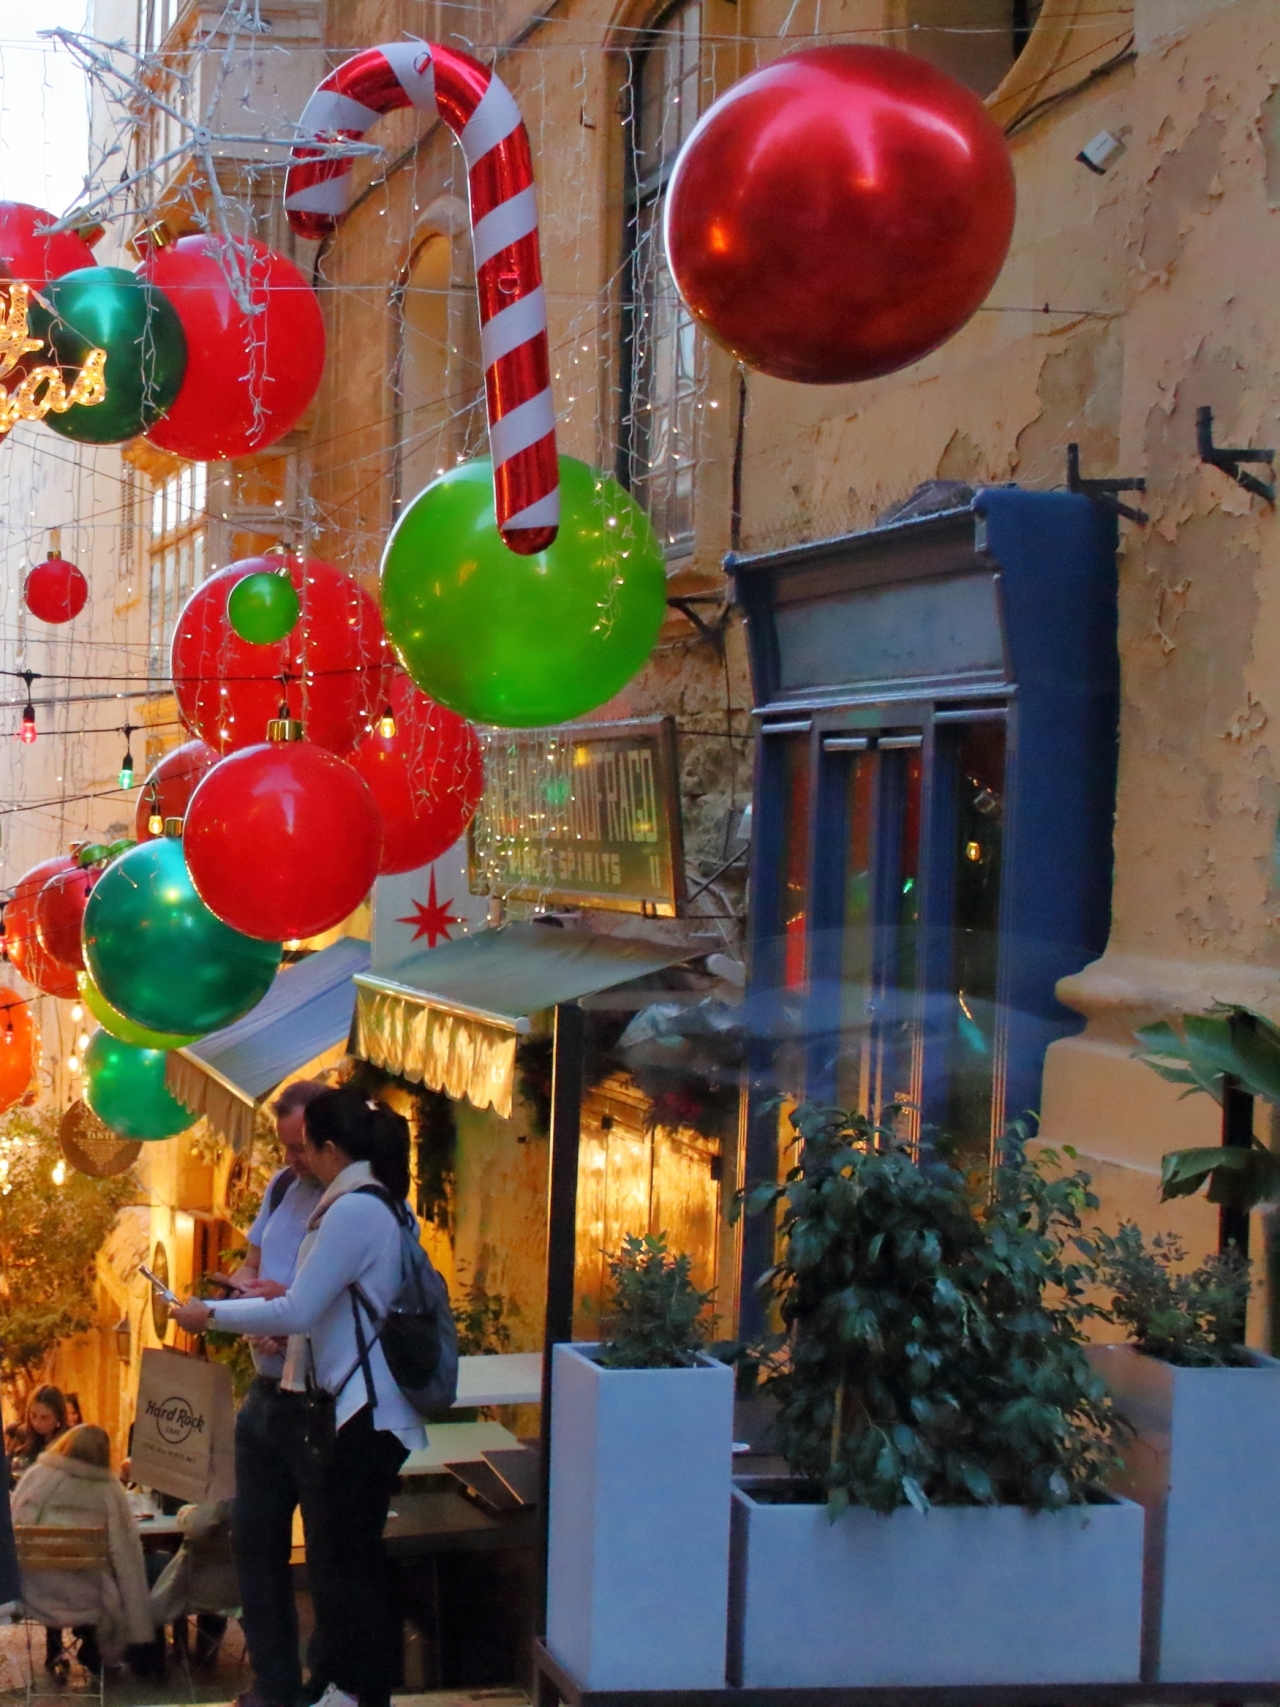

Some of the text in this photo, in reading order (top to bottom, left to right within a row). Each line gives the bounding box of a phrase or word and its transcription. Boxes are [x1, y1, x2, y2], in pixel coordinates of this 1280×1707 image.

[558, 851, 621, 886] SPIRITS
[145, 1400, 205, 1434] Hard Rock
